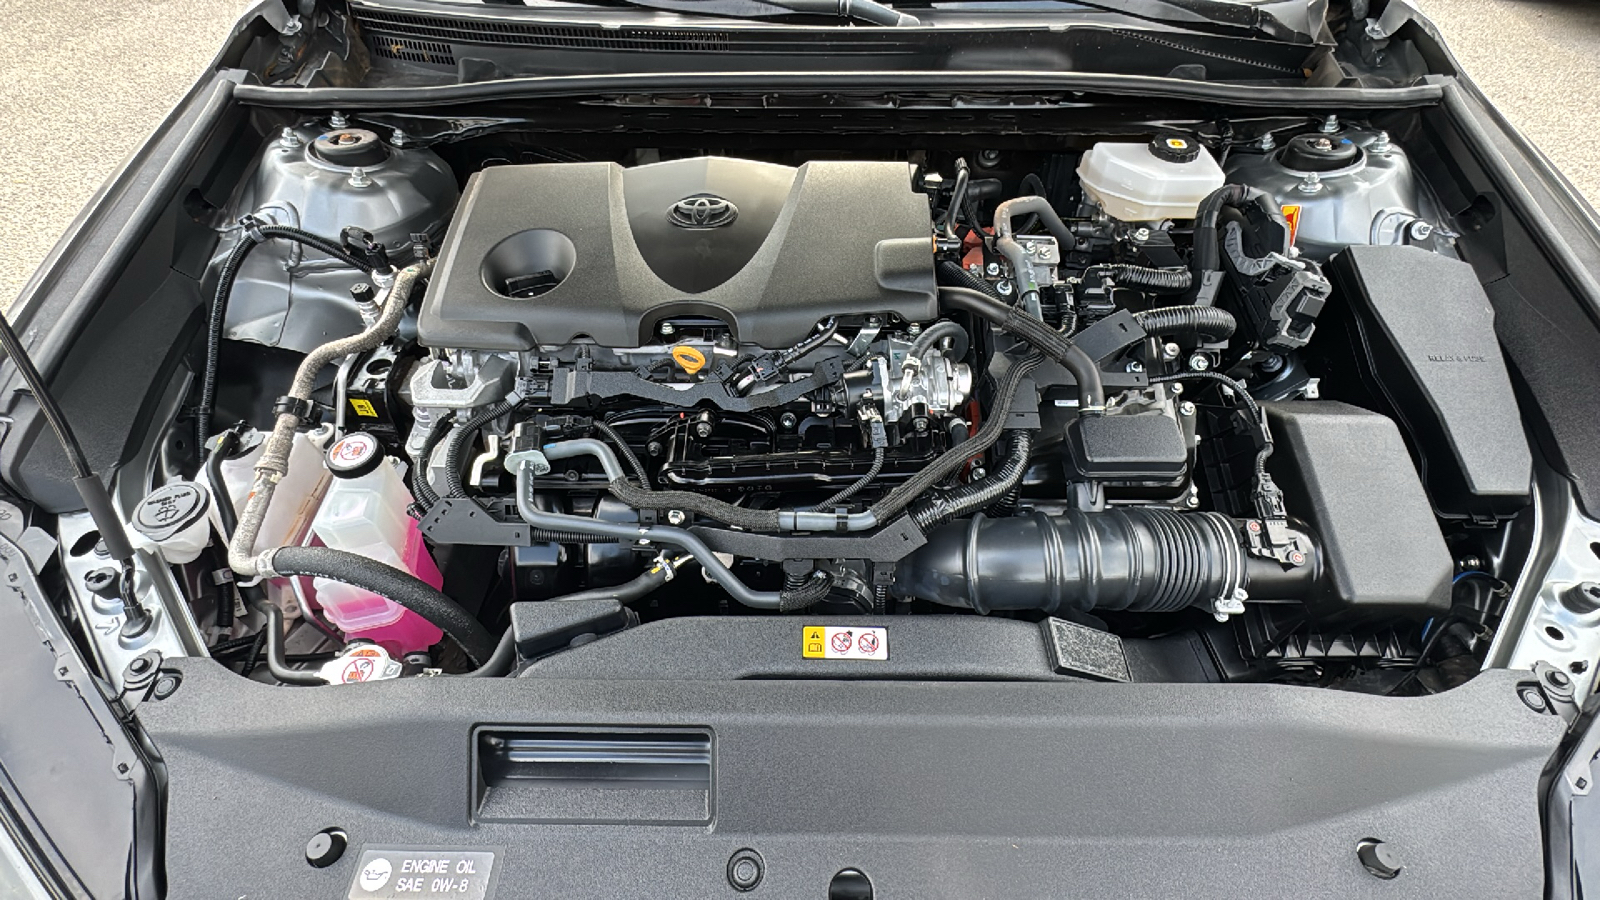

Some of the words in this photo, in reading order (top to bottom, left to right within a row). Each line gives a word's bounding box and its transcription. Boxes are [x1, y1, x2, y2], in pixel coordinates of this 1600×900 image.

[401, 859, 450, 874] ENGINE
[456, 860, 477, 874] OIL
[395, 878, 424, 892] SAE
[431, 879, 469, 893] 0W-8
